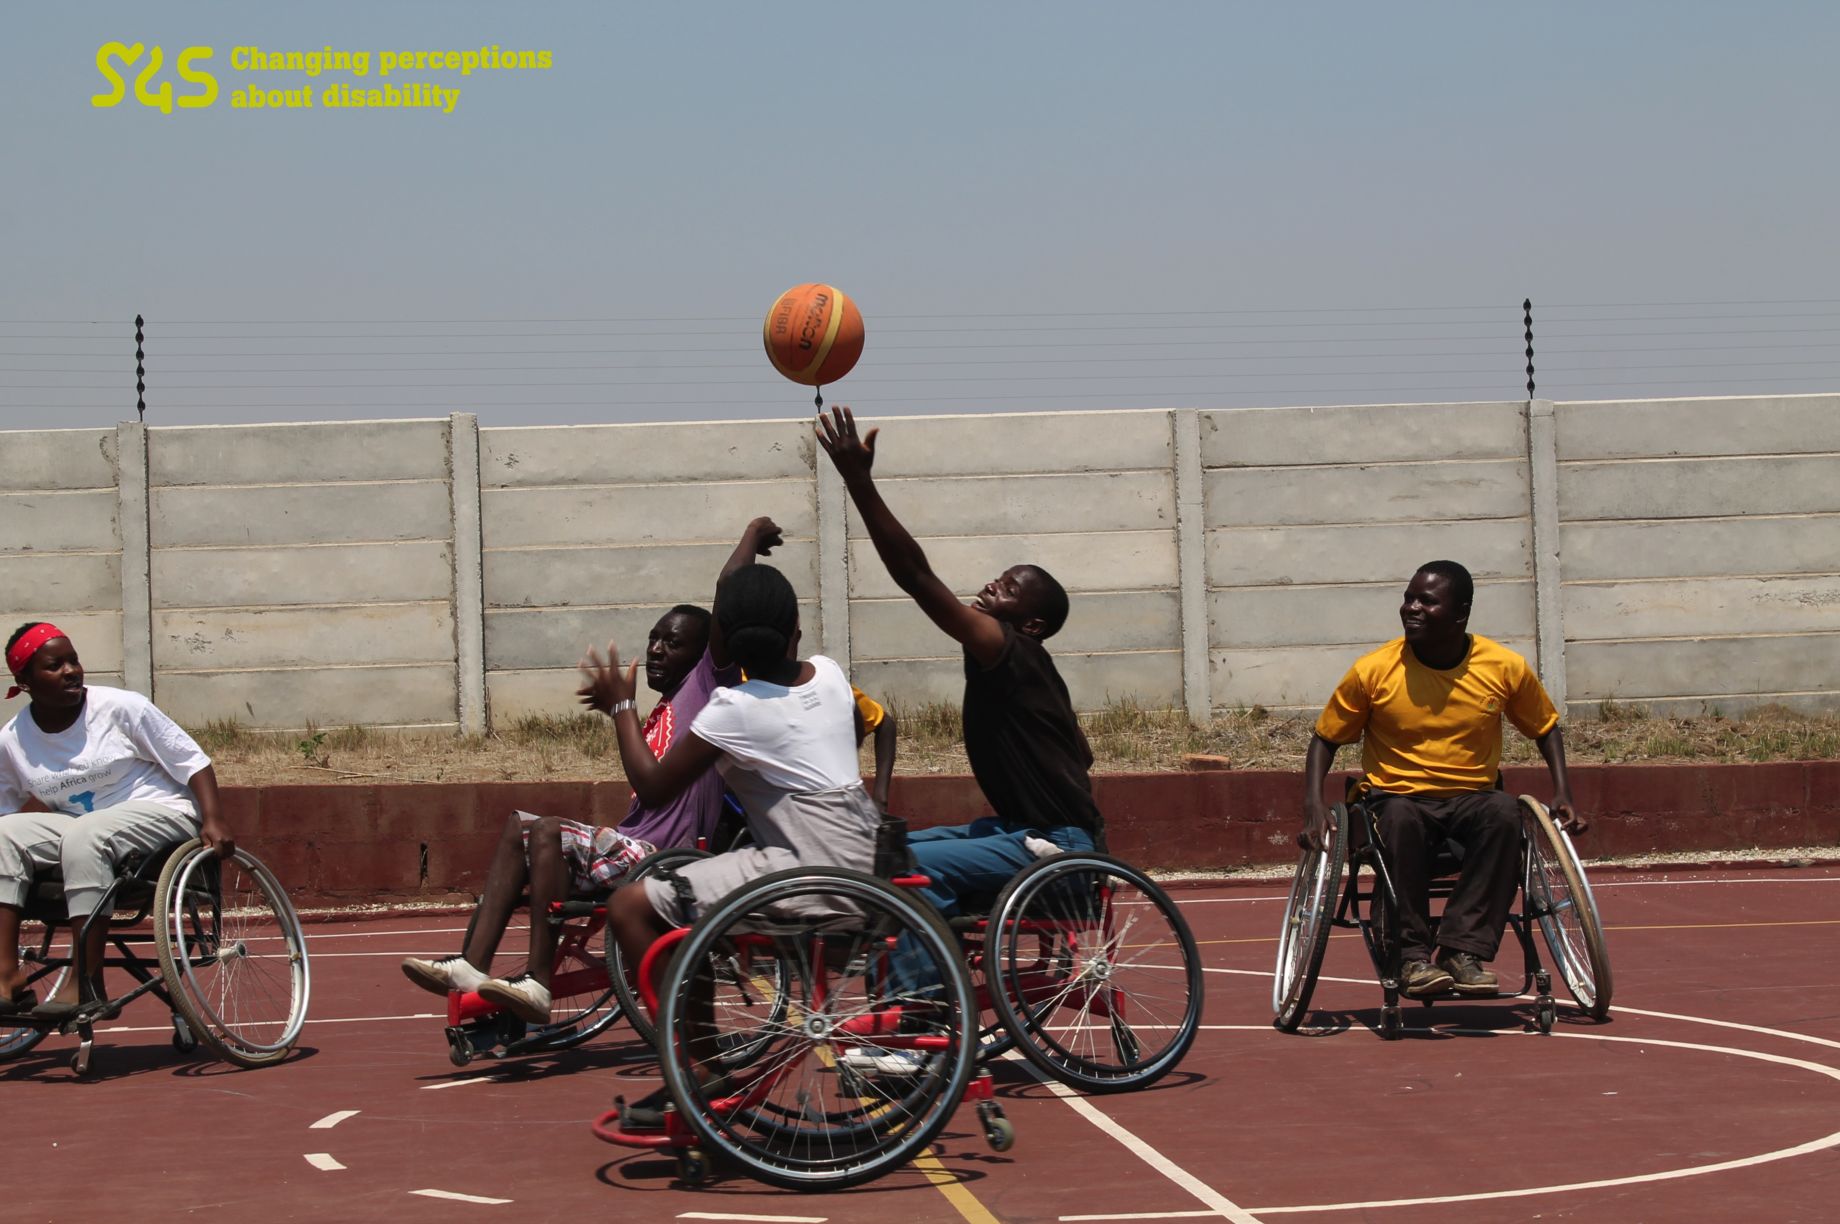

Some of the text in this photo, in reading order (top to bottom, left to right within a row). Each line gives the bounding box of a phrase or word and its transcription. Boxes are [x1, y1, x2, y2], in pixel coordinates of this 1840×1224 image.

[40, 768, 113, 797] help Africa grow
